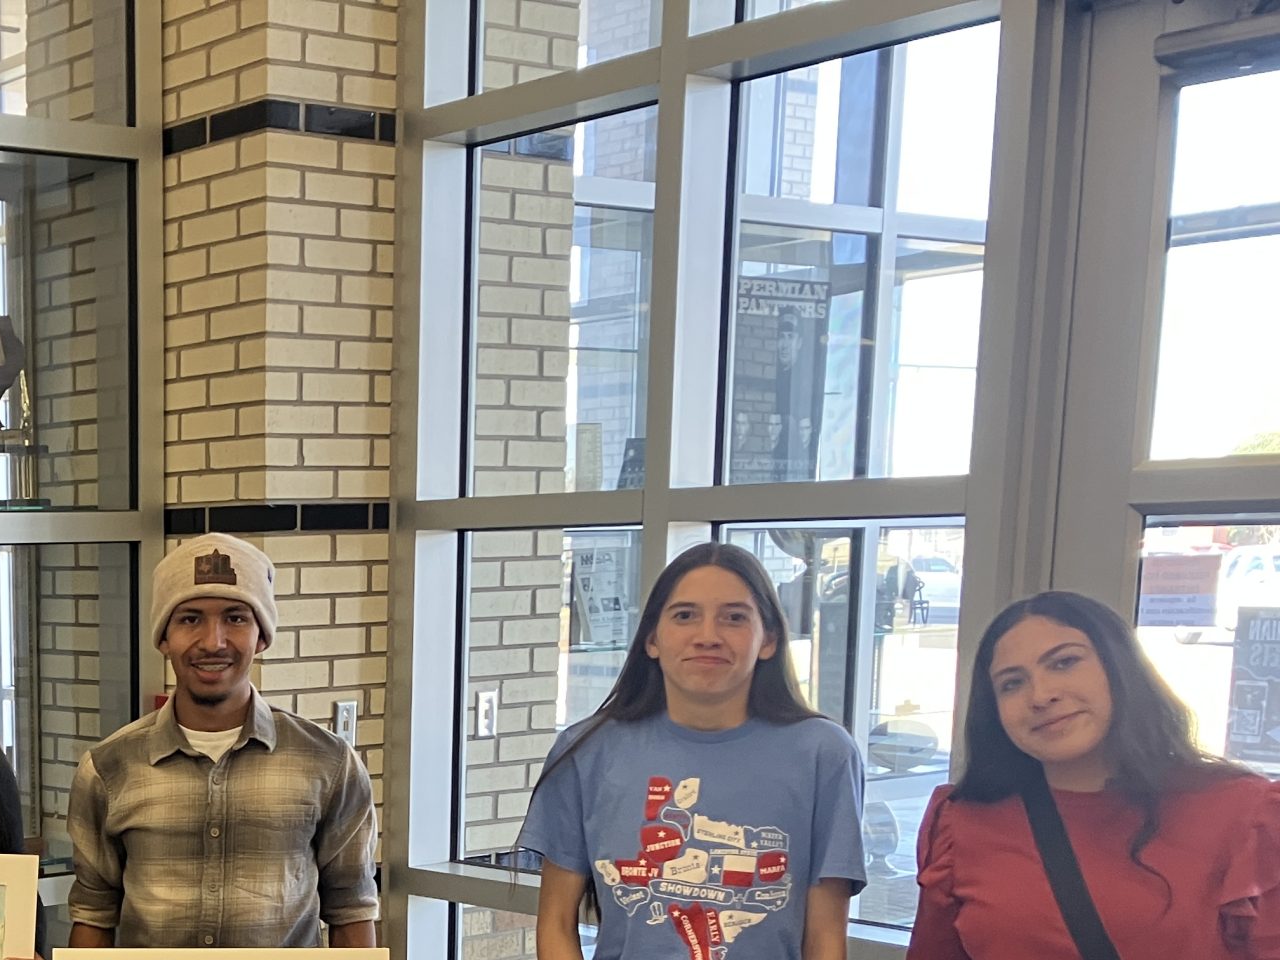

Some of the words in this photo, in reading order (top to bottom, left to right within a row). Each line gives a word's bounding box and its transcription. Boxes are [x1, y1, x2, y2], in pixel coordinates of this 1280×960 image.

[738, 279, 828, 300] PERMIAN
[738, 298, 827, 318] PANTRS
[645, 838, 682, 853] JUNCTION
[759, 864, 786, 875] MARFA
[660, 882, 725, 901] SHOWDOWN
[706, 911, 721, 943] EARLY
